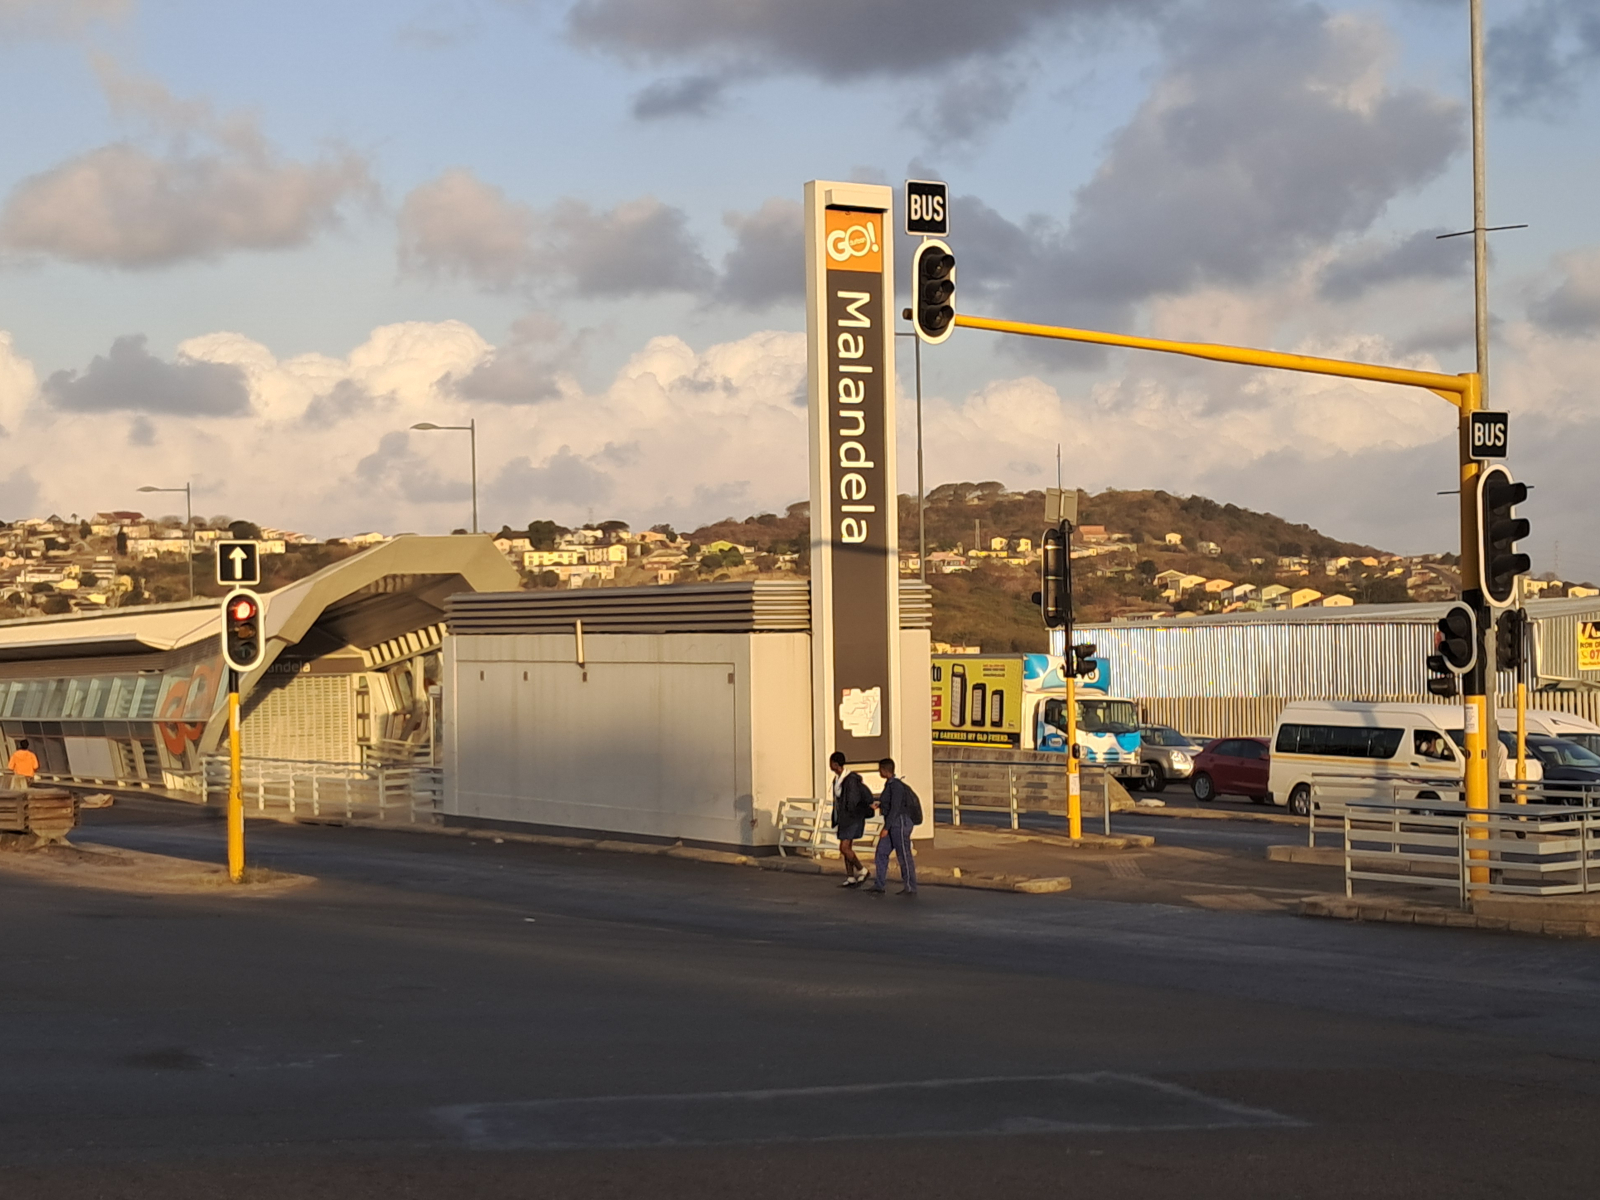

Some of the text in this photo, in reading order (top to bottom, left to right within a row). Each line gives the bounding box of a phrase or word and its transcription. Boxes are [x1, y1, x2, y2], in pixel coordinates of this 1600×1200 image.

[910, 194, 944, 222] BUS
[836, 290, 876, 544] Malandela
[1474, 422, 1505, 447] BUS
